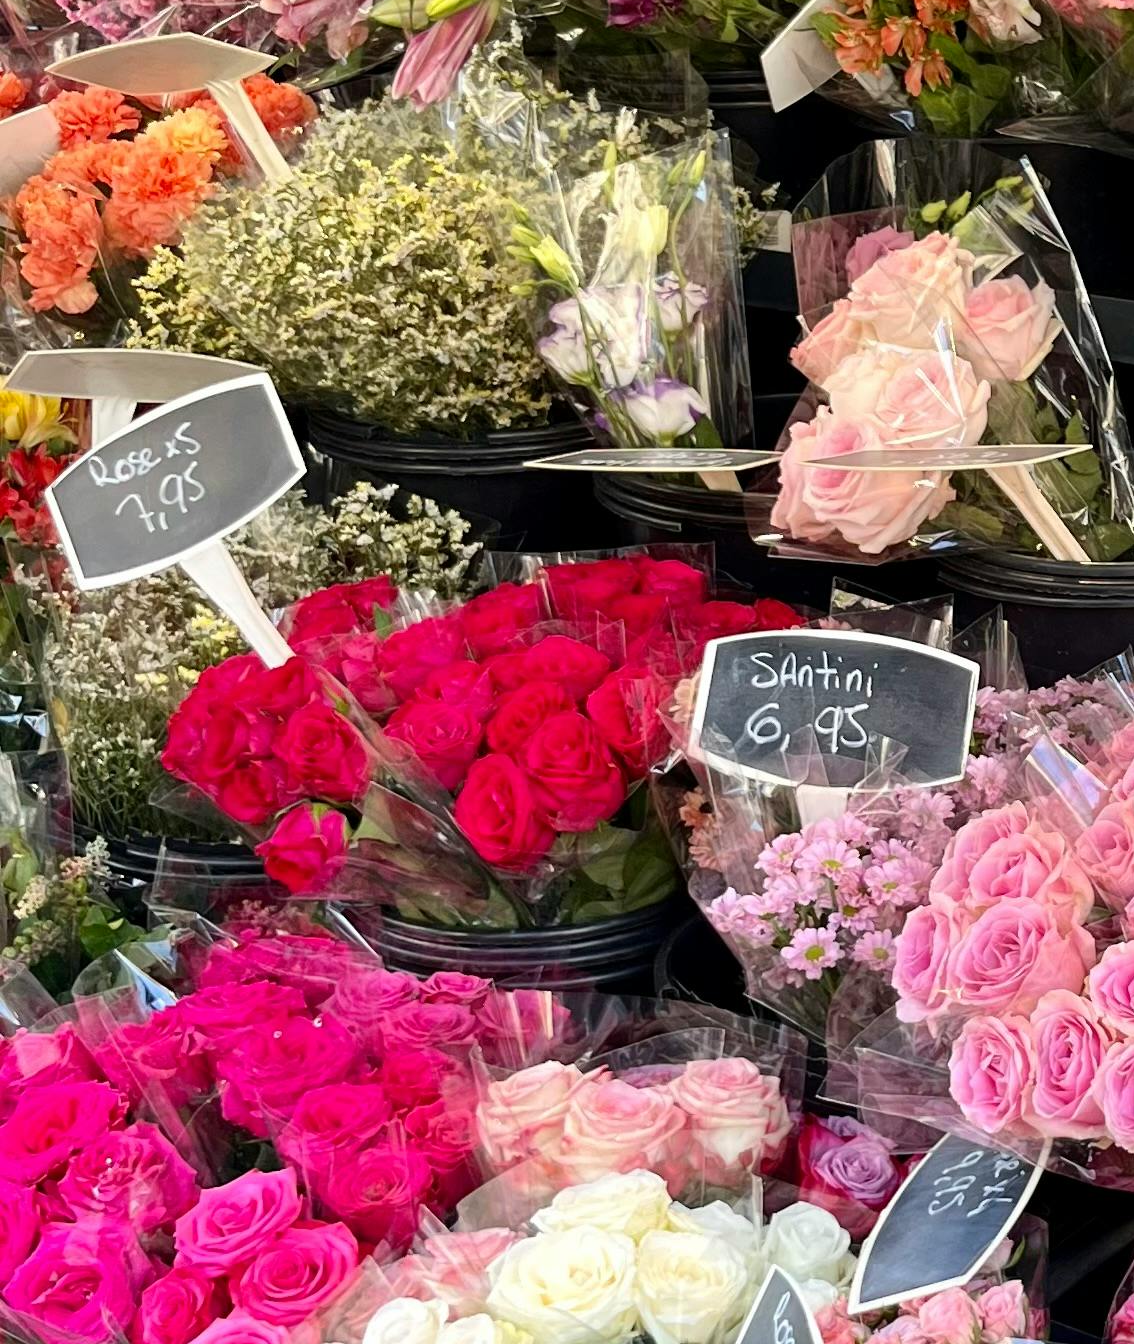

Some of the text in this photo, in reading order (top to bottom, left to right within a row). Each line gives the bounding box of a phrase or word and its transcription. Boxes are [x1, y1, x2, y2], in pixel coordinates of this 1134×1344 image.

[88, 421, 202, 487] Rose x5
[115, 461, 206, 533] 7,95
